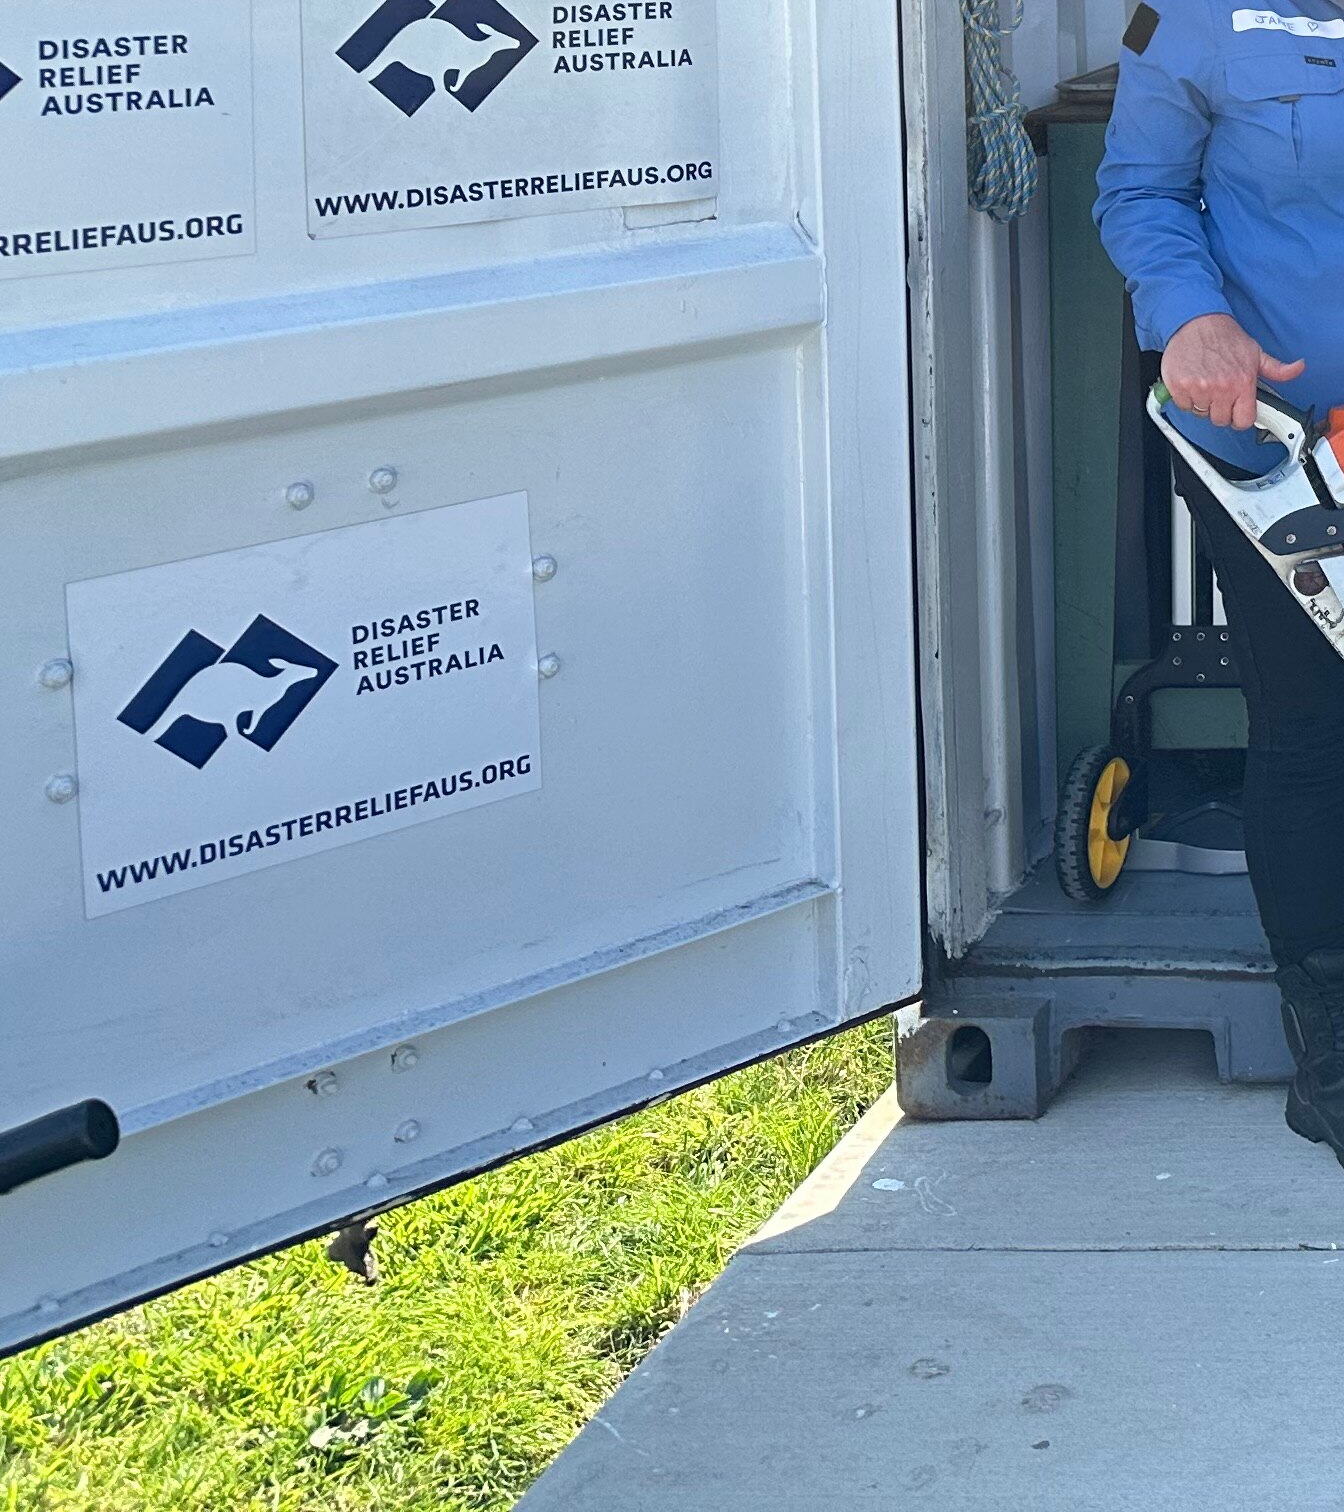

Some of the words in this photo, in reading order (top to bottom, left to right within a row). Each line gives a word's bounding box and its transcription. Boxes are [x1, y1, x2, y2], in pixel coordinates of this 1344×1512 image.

[552, 0, 674, 25] DISASTER
[38, 33, 190, 61] DISASTER
[552, 27, 635, 50] RELIEF
[38, 62, 142, 89] RELIEF
[553, 48, 694, 74] AUSTRALIA
[40, 86, 215, 117] AUSTRALIA
[315, 160, 714, 217] WWW.DISASTERRELIEFAUS.ORG
[351, 599, 480, 643] DISASTER
[353, 633, 441, 669] RELIEF
[356, 644, 504, 695] AUSTRALIA
[97, 755, 531, 892] WWW.DISASTERRELIEFAUS.ORG
